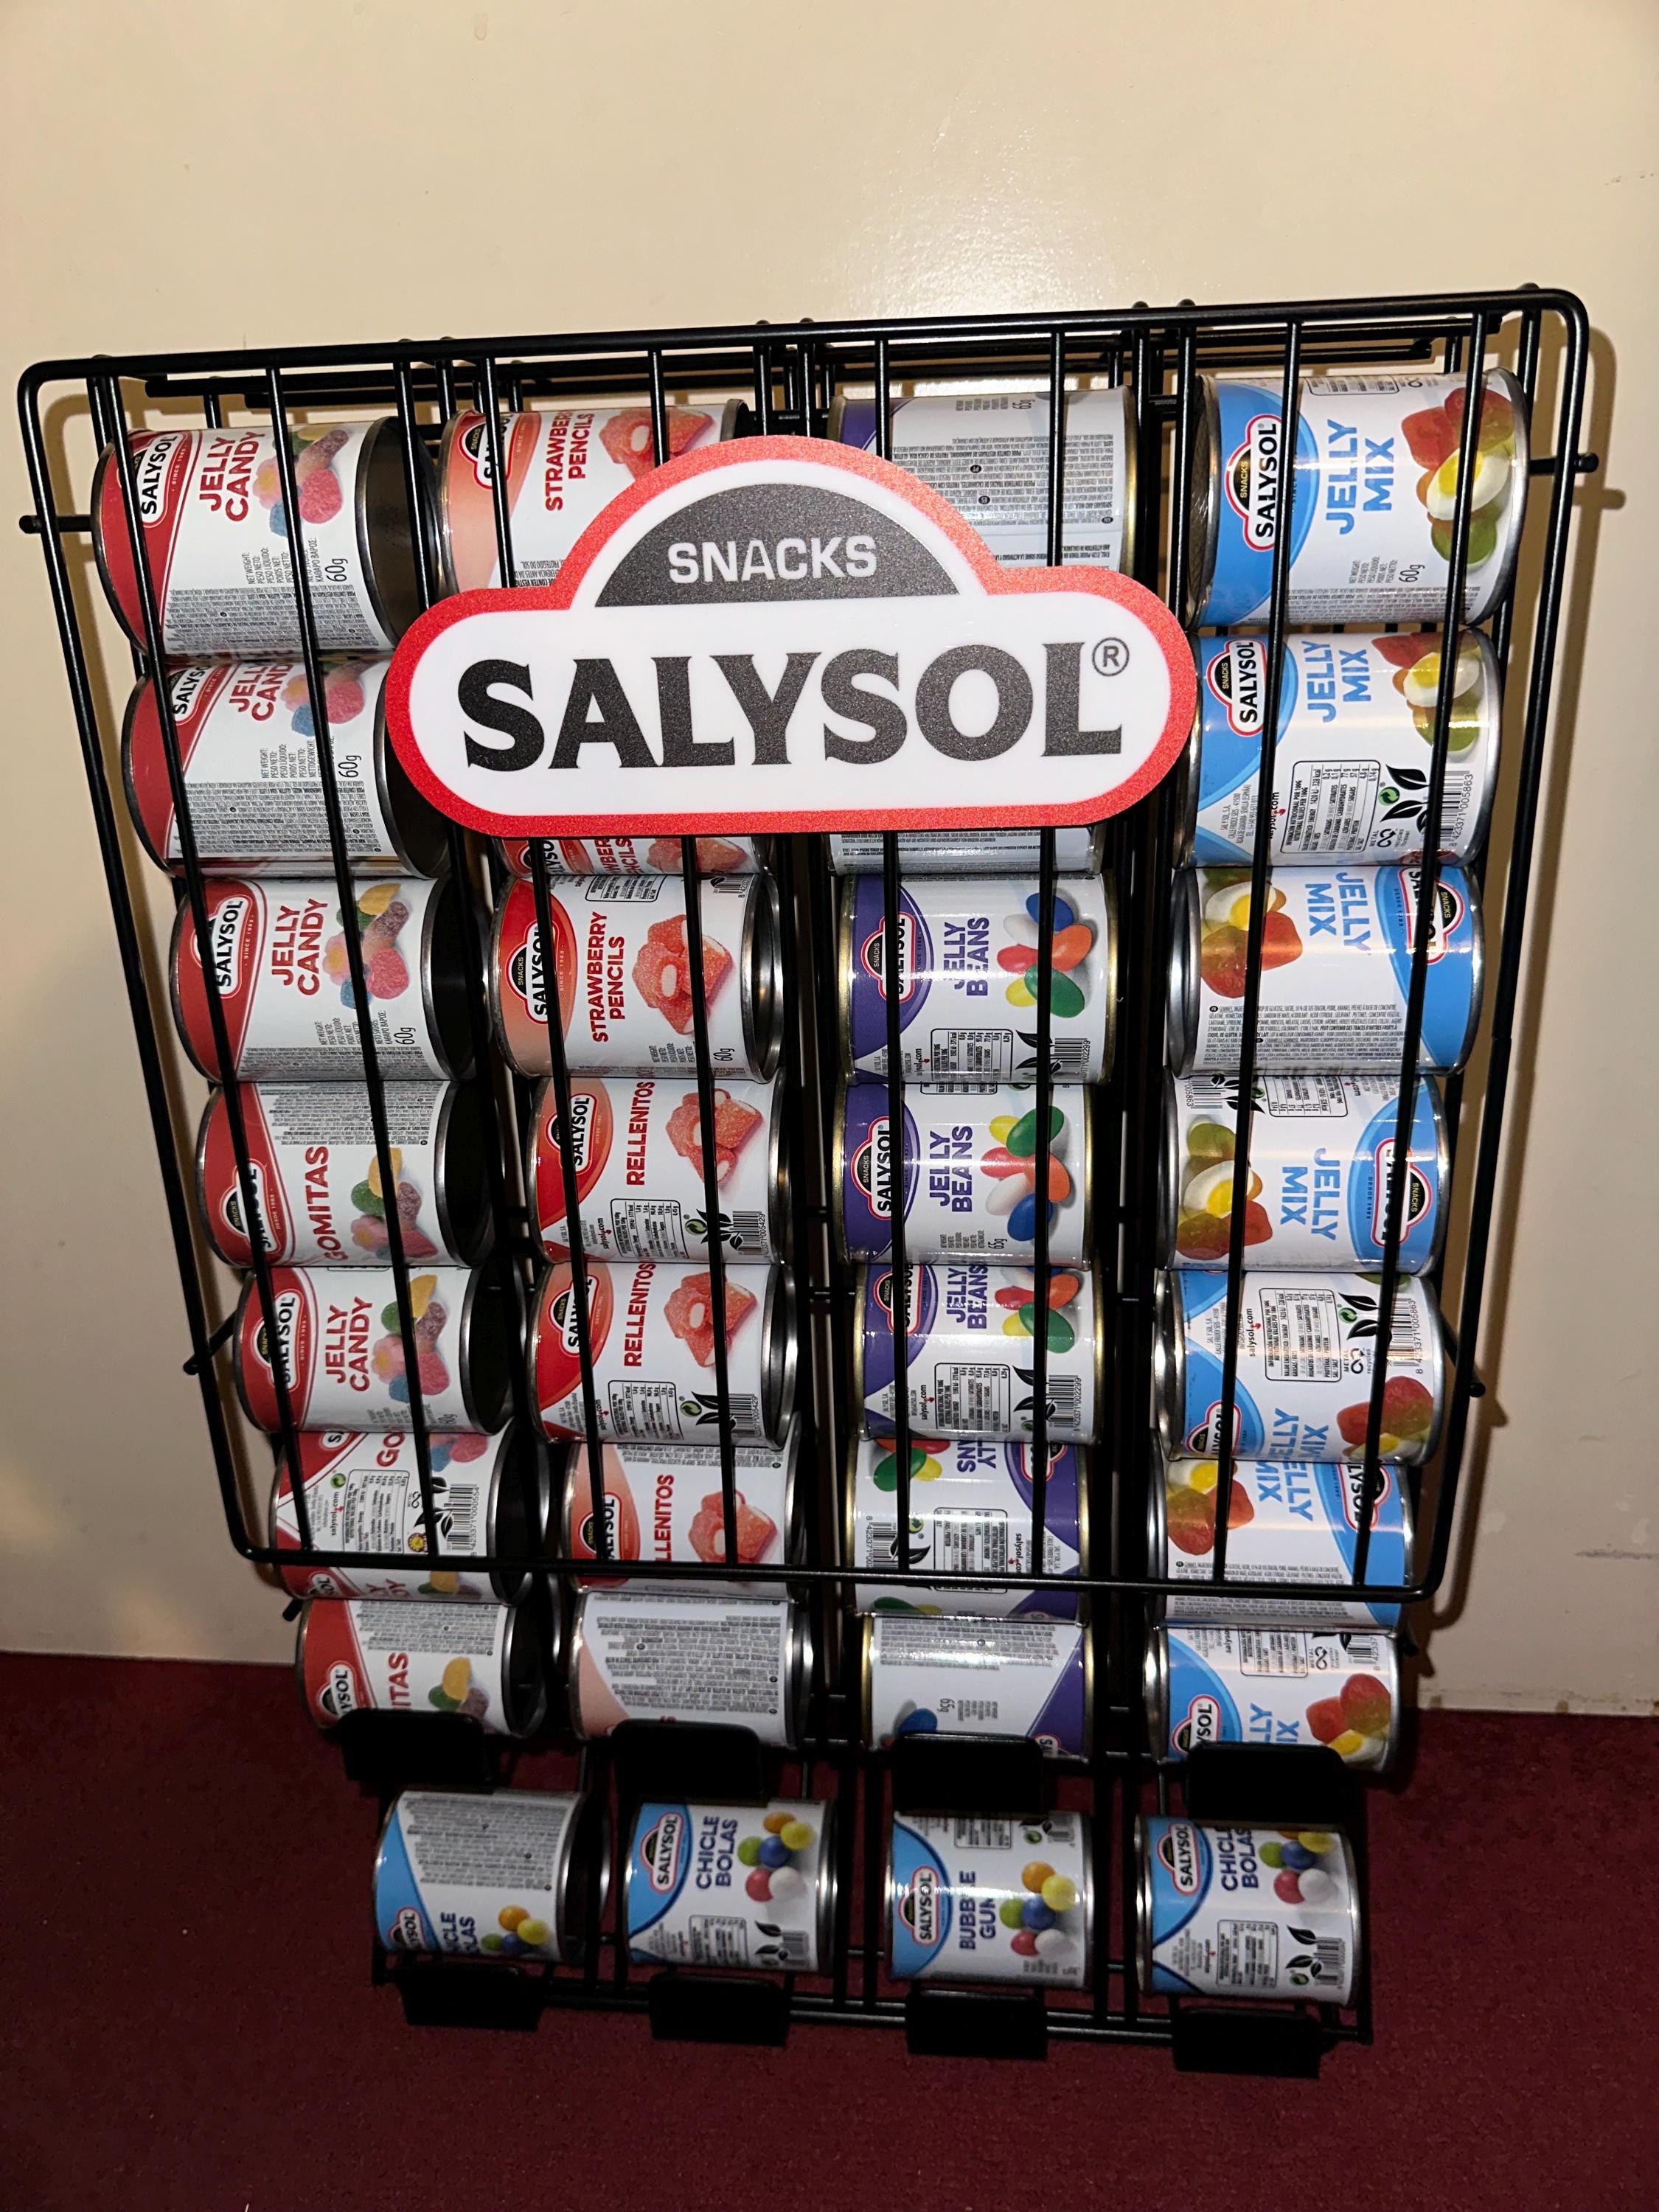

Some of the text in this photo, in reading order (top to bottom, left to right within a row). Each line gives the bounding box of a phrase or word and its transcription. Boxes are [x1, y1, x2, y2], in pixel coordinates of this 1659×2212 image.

[142, 435, 178, 515] SALYSOL
[199, 437, 236, 512] JELLY
[225, 431, 265, 521] CANDY
[568, 412, 595, 479] PENCILS
[1239, 460, 1248, 498] SNACKS
[1256, 423, 1277, 538] SALYSOL
[1326, 419, 1357, 535] JELLY
[1363, 437, 1394, 511] MIX
[324, 558, 349, 582] 60g
[667, 535, 877, 584] SNACKS
[1399, 565, 1425, 582] 60g
[1237, 641, 1258, 723] SALYSOL
[1301, 641, 1336, 723] JELLY
[1338, 649, 1371, 702] MIX
[338, 755, 361, 778] 60g
[1460, 773, 1473, 809] 005863
[1304, 883, 1335, 936] MIX
[1335, 872, 1371, 952] JELLY
[1441, 891, 1450, 919] SNACKS
[216, 900, 243, 987] SALYSOL
[271, 905, 301, 985] JELLY
[297, 898, 328, 995] CANDY
[588, 911, 609, 1043] STRAWBERRY
[607, 936, 625, 1020] PENCILS
[966, 917, 990, 996] BEANS
[394, 1027, 416, 1045] 60g
[712, 1048, 735, 1062] 60g
[573, 1097, 590, 1166] SALYSOL
[626, 1081, 655, 1186] RELLENITOS
[929, 1130, 951, 1207] JELLY
[305, 1146, 349, 1261] GOMITAS
[951, 1126, 973, 1213] BEANS
[1280, 1166, 1308, 1225] MIX
[1311, 1147, 1340, 1241] JELLY
[988, 1238, 1007, 1250] 65g
[624, 1262, 656, 1367] RELLENITOS
[946, 1267, 967, 1324] JELLY
[967, 1262, 988, 1329] BEANS
[1245, 1308, 1256, 1357] salysol.com
[325, 1304, 348, 1384] JELLY
[348, 1296, 373, 1392] CANDY
[937, 1698, 955, 1712] 65g
[657, 1817, 678, 1885] SALYSOL
[695, 1815, 720, 1890] CHICLE
[715, 1818, 738, 1887] BOLAS
[919, 1873, 932, 1941] SALYSOL
